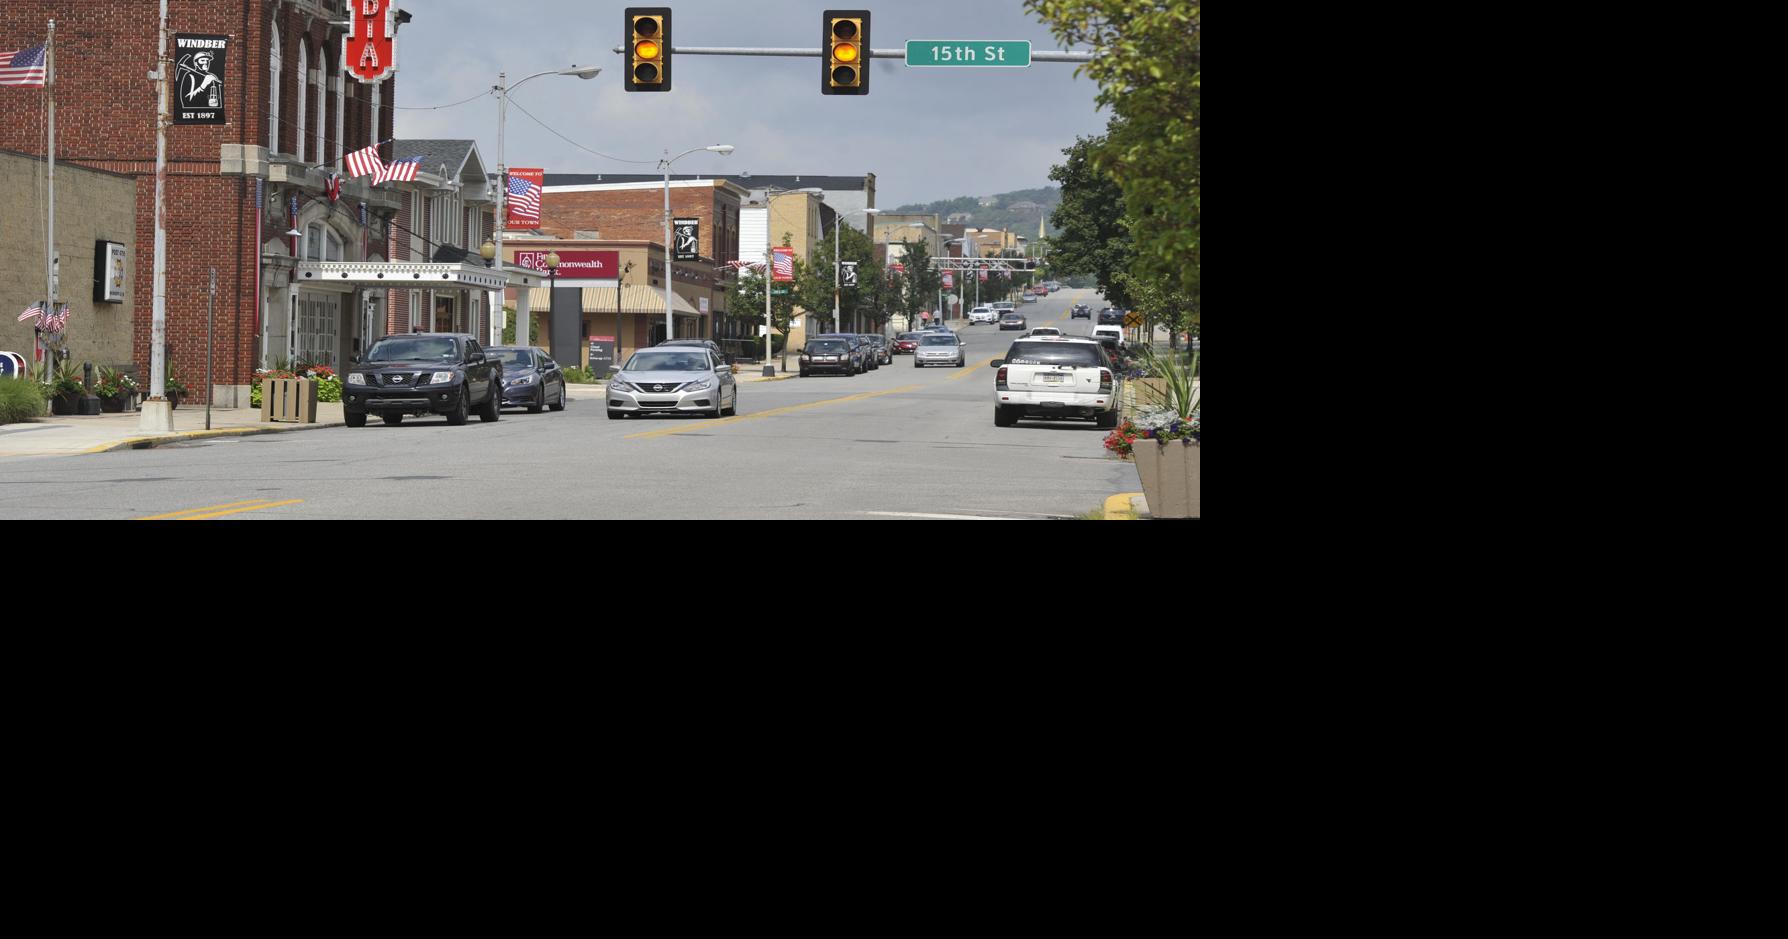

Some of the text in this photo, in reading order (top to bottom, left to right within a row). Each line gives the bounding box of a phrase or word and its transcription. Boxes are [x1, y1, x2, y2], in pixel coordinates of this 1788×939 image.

[177, 38, 226, 49] WINDBER
[931, 46, 1005, 61] 15th St
[535, 259, 603, 268] Comonwealth
